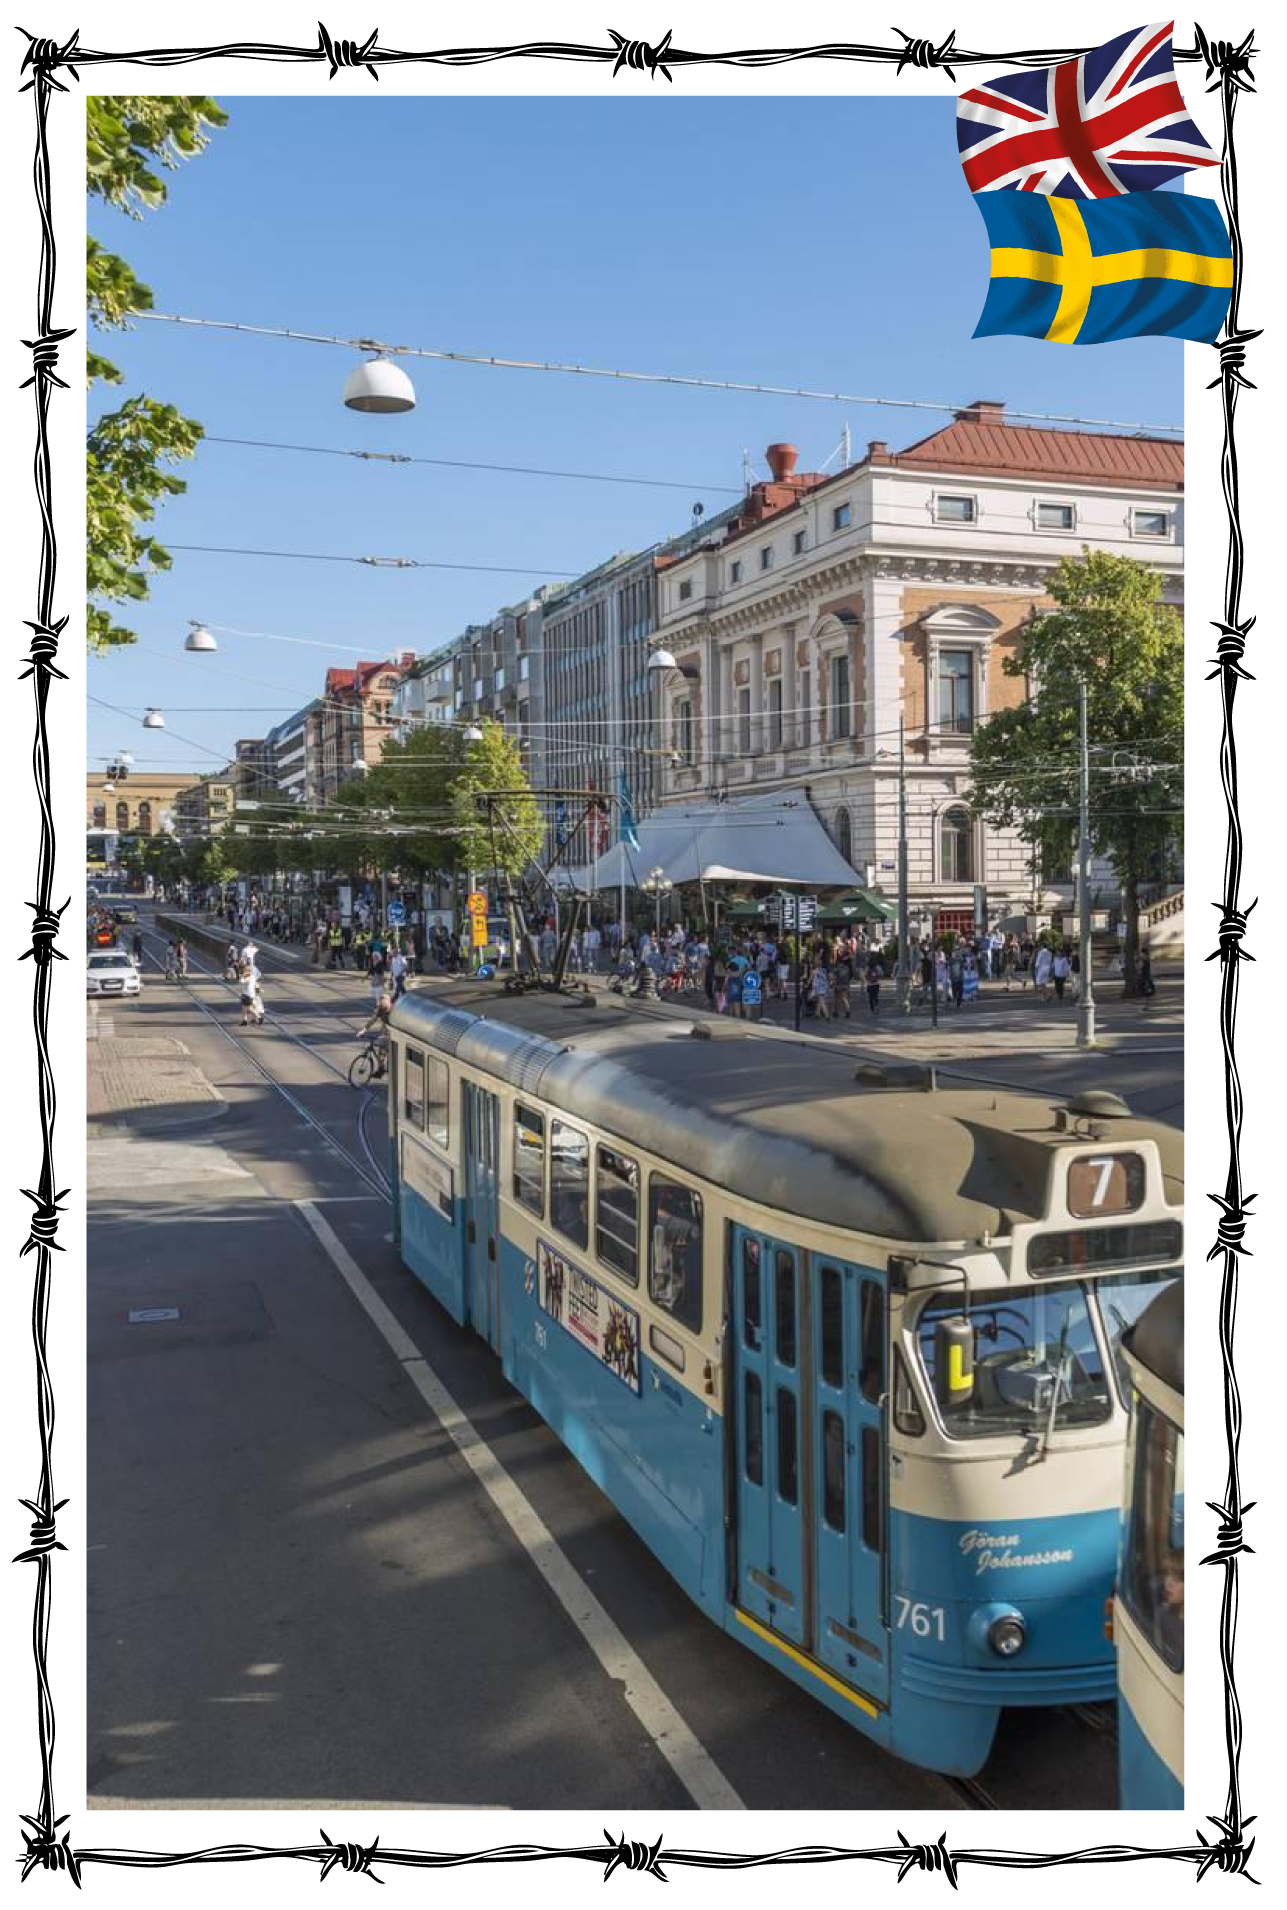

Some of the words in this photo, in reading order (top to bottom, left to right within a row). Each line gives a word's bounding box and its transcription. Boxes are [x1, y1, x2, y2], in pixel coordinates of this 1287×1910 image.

[1088, 1156, 1114, 1206] 7
[534, 1321, 547, 1350] 761
[960, 1530, 1020, 1554] Göran
[976, 1549, 1073, 1575] Johansson
[894, 1595, 944, 1641] 761
